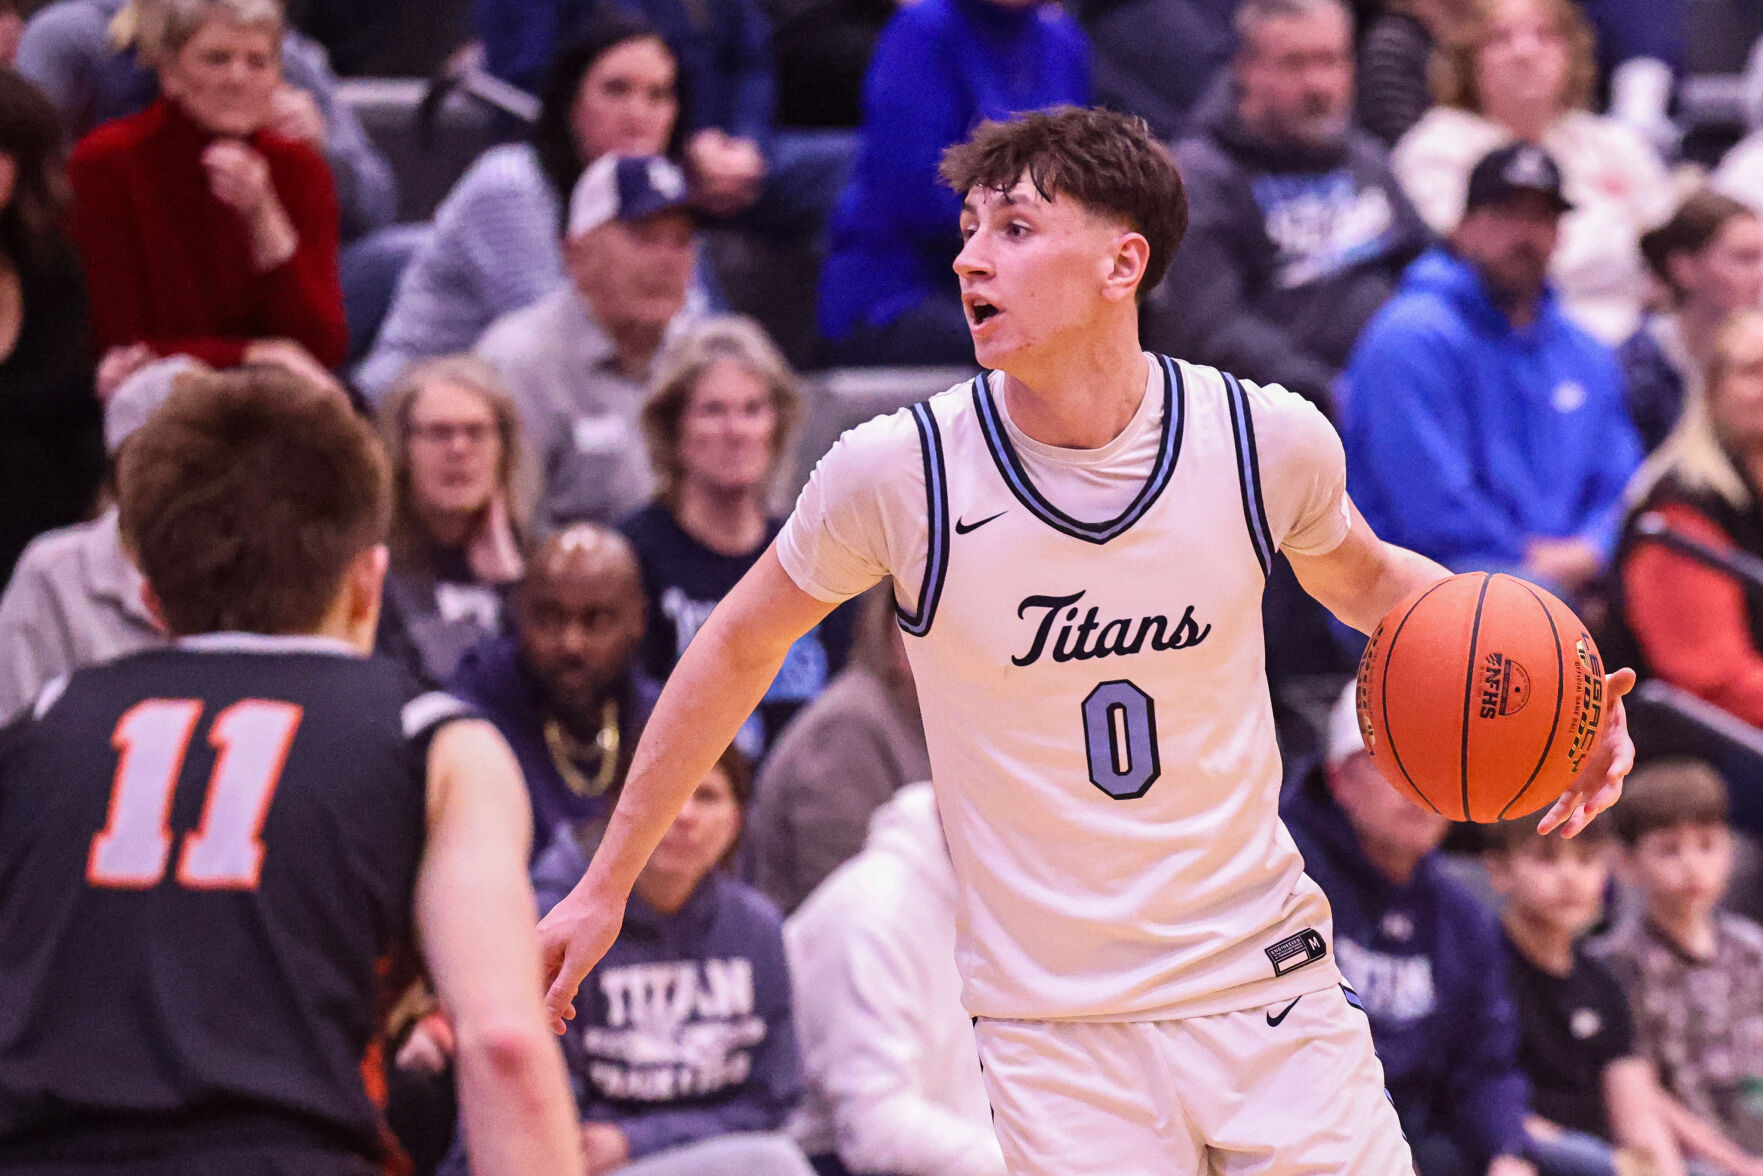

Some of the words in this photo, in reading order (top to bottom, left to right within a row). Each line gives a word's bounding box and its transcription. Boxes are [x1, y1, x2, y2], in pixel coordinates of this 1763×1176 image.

[1011, 590, 1212, 667] Titans
[1480, 667, 1502, 719] NFHS
[1572, 632, 1603, 773] LEGACY
[1573, 694, 1581, 715] GAME
[1574, 661, 1582, 693] OFFICIAL
[1081, 679, 1162, 800] 0
[1568, 674, 1591, 759] 1000
[85, 697, 304, 892] 11
[1308, 936, 1321, 951] M
[600, 958, 755, 1027] TITAN
